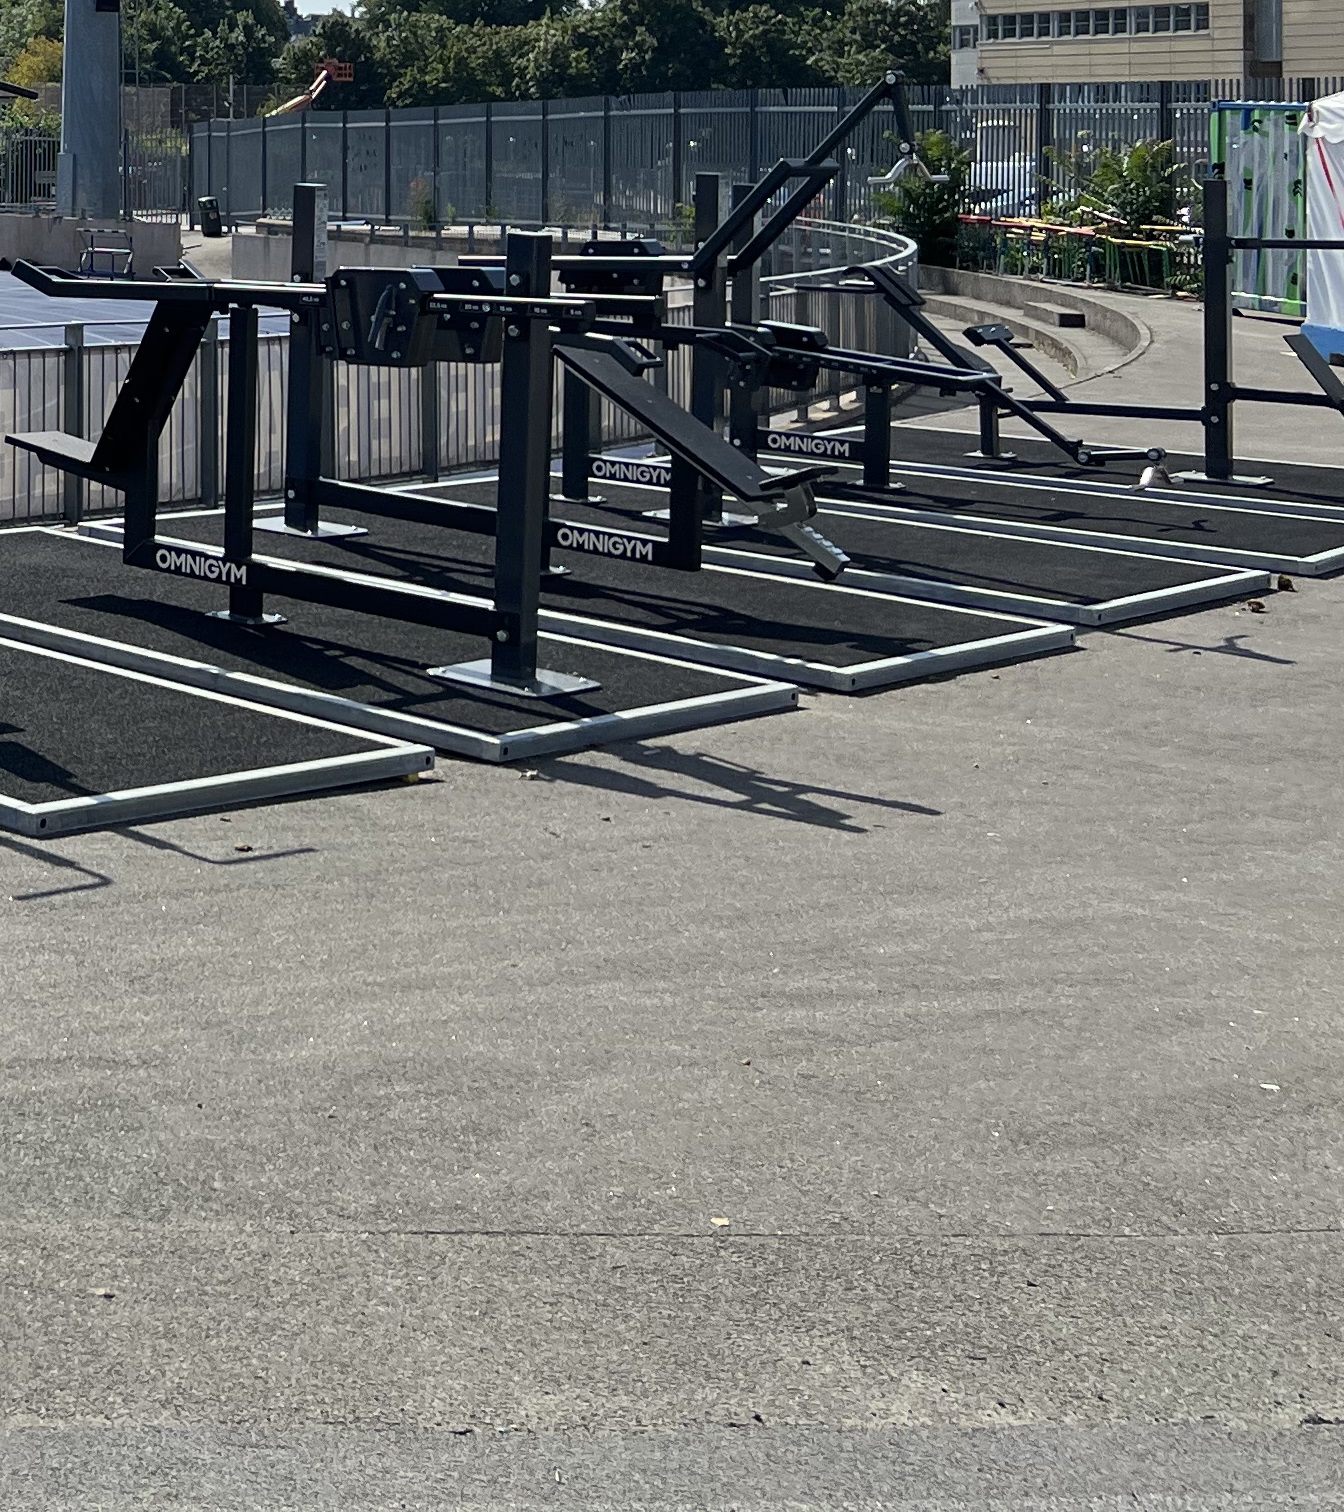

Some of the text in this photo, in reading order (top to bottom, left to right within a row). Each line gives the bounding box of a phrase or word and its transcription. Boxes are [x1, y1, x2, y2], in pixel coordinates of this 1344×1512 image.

[767, 433, 850, 457] OMNIGYM
[592, 460, 671, 484] OMNIGYM
[556, 527, 653, 561] OMNIGYM
[155, 548, 247, 586] OMNIGYM
